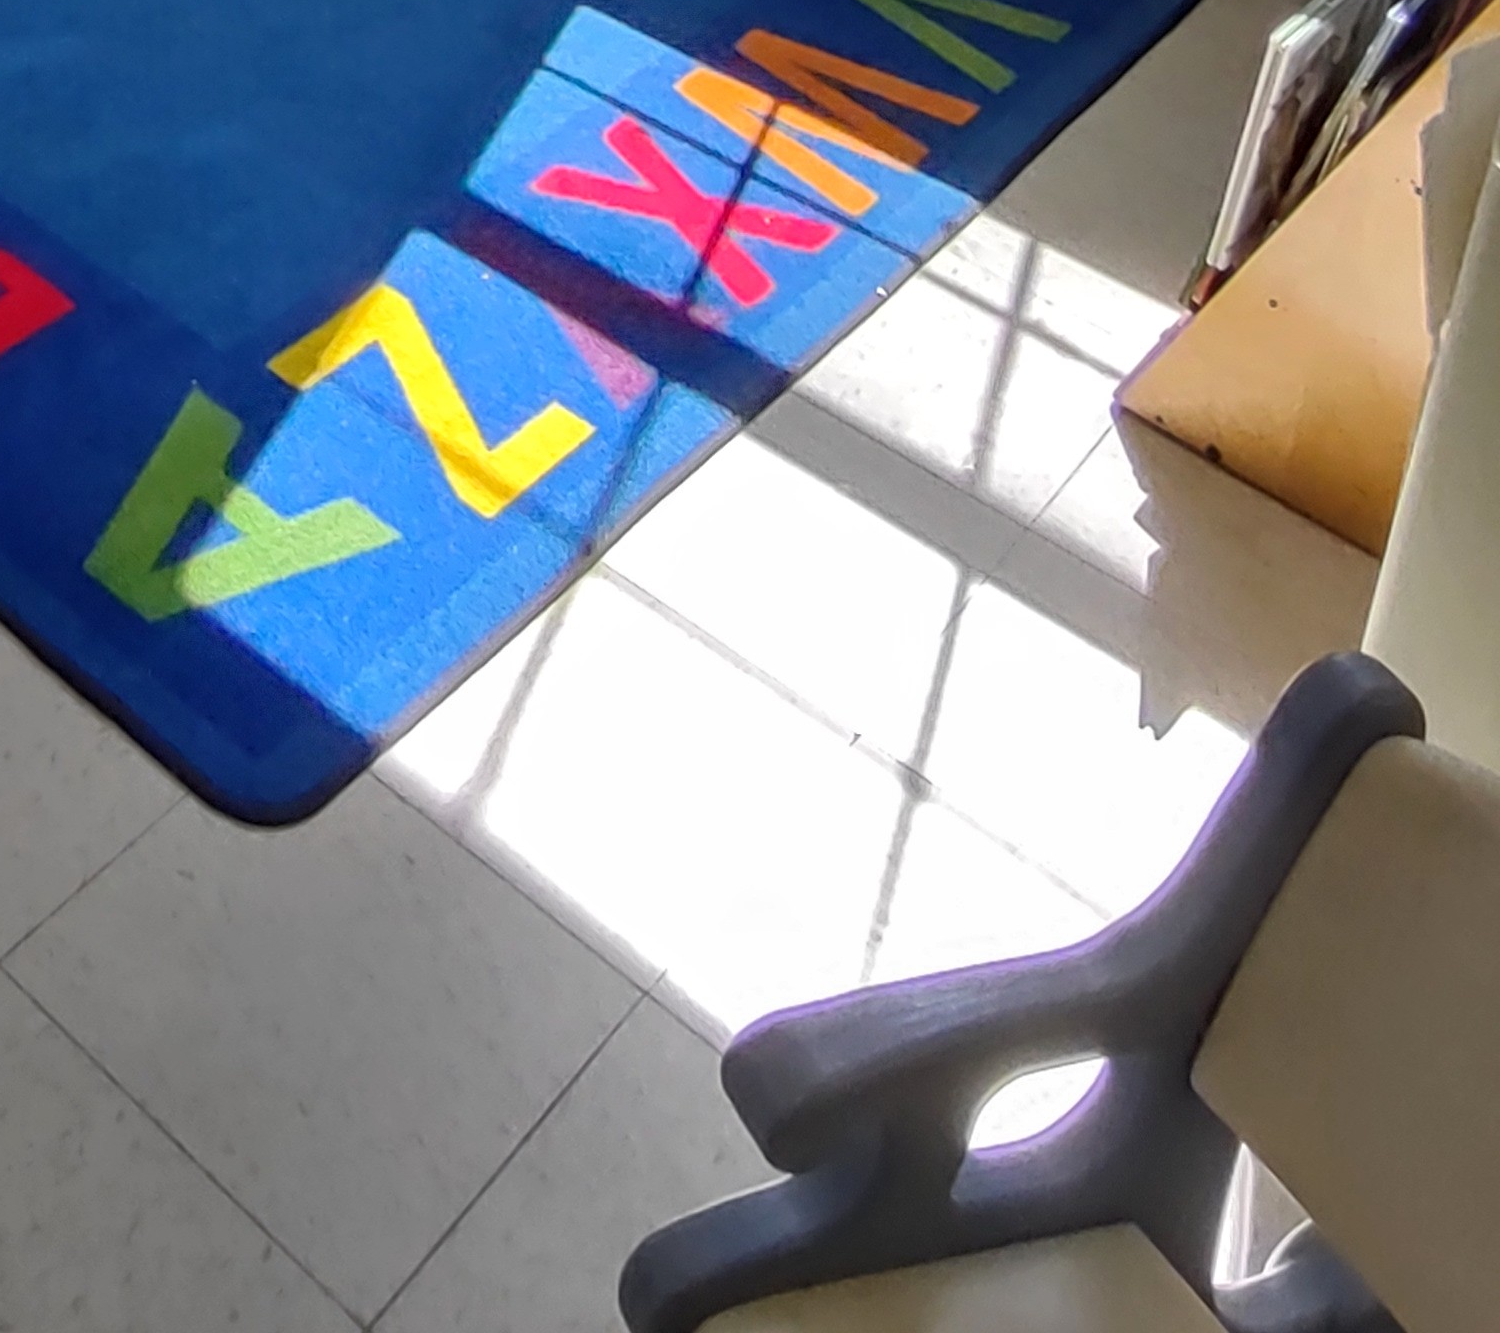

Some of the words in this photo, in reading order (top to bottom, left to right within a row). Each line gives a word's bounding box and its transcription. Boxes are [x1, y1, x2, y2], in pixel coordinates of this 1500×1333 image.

[530, 114, 841, 307] X
[673, 28, 981, 216] W
[83, 387, 402, 622] A
[265, 284, 597, 519] Z
